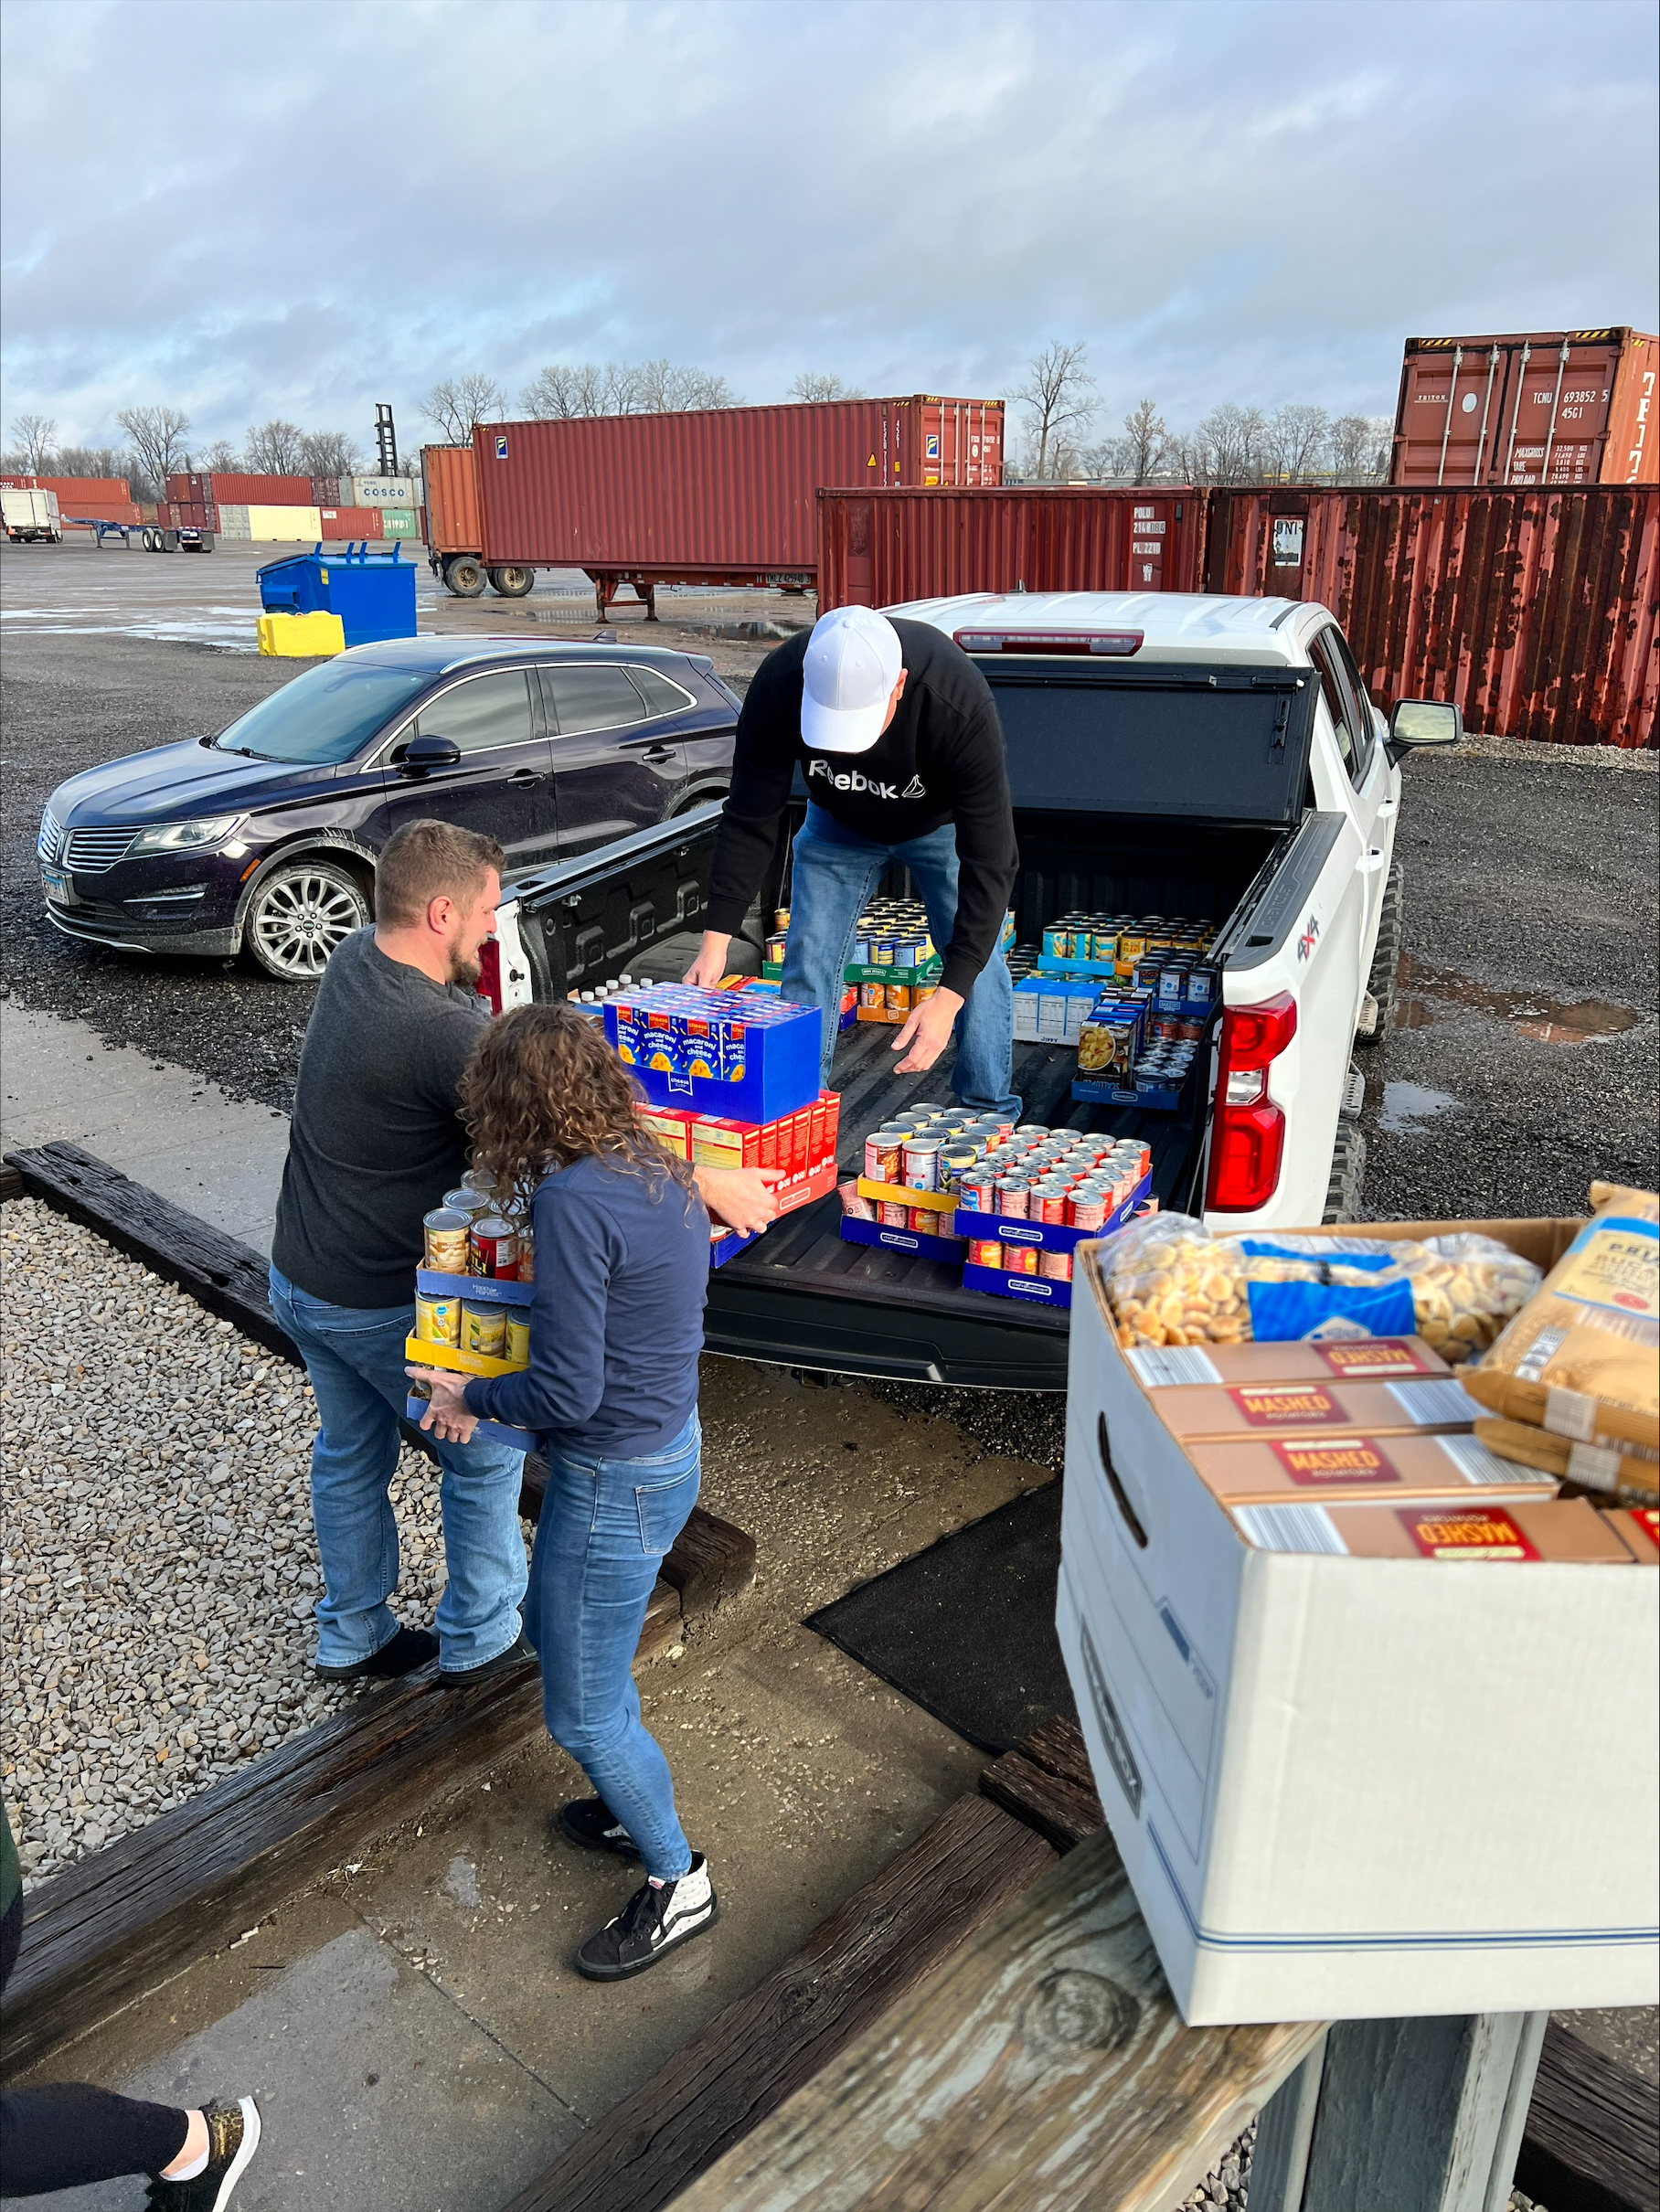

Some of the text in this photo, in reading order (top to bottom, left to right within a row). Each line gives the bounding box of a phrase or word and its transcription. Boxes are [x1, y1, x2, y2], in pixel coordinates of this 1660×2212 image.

[1533, 389, 1609, 404] TCNU 693852 5
[1561, 407, 1583, 419] 45G1
[364, 488, 405, 496] COSCO
[1134, 506, 1150, 519] POLU
[1133, 543, 1161, 554] PL 2210
[809, 760, 899, 799] Reebok
[644, 1032, 676, 1044] macaroni
[683, 1038, 717, 1050] macaroni
[648, 1041, 673, 1052] cheese
[687, 1048, 712, 1058] cheese
[1328, 1348, 1410, 1365] MASHED
[1244, 1395, 1332, 1413] MASHED
[1287, 1450, 1381, 1471] MASHED
[1416, 1521, 1518, 1545] MASHED
